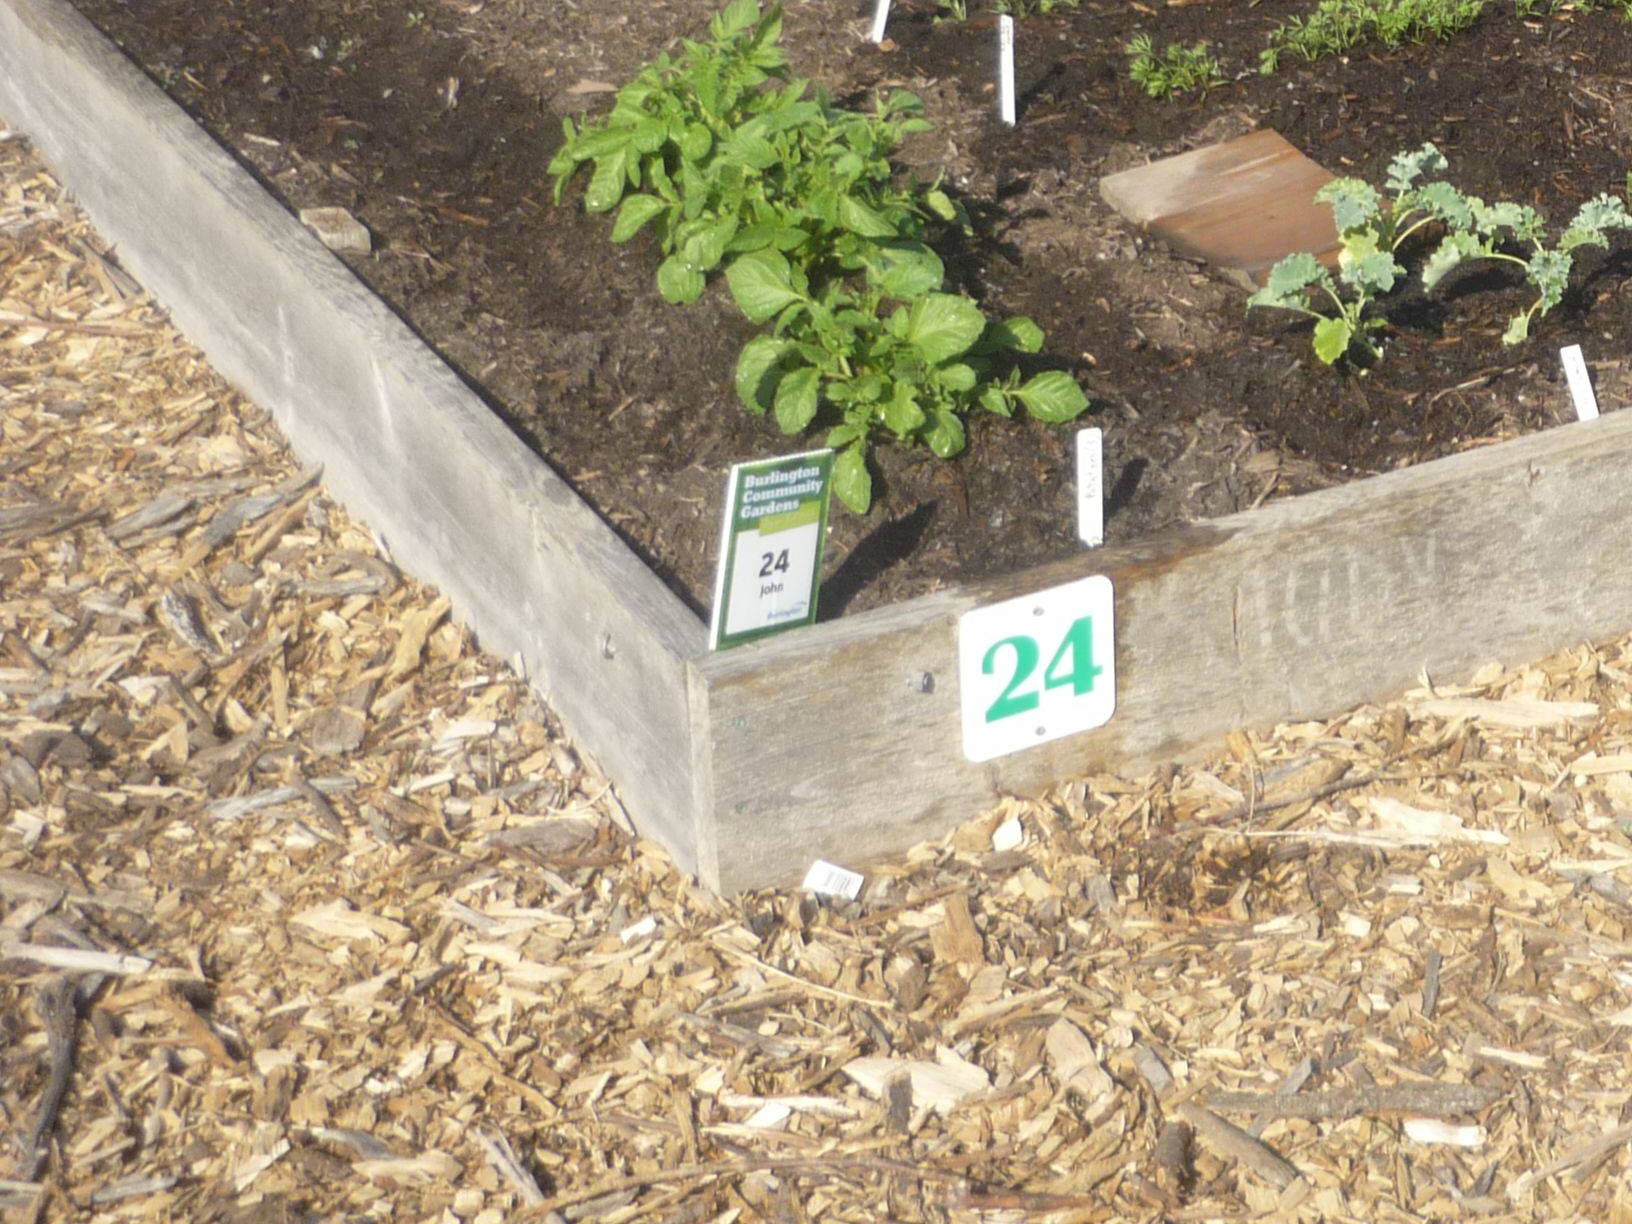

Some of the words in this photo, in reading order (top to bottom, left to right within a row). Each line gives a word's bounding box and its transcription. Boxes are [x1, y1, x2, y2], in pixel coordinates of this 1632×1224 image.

[745, 467, 820, 488] Burlington
[743, 478, 824, 504] Community
[741, 500, 799, 518] Gardens
[759, 549, 790, 577] 24
[760, 583, 784, 598] John
[981, 615, 1103, 724] 24
